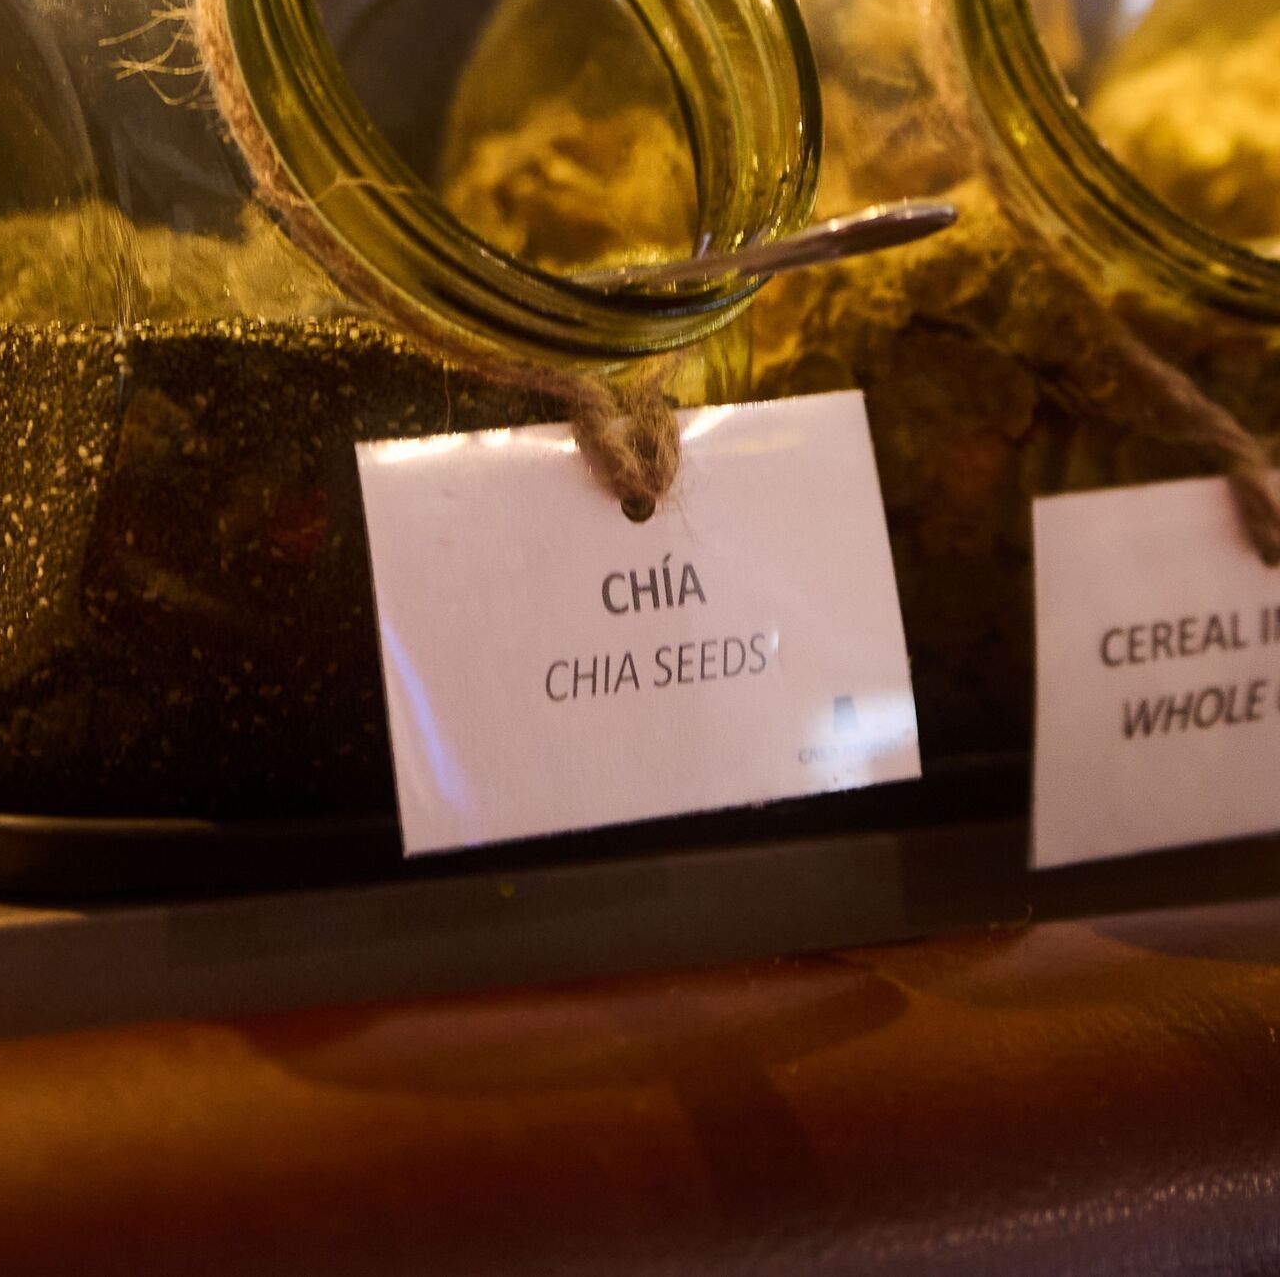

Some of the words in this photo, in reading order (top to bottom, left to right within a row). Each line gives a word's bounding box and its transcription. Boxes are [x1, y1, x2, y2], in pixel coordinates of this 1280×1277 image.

[601, 554, 706, 615] CHÍA
[545, 651, 640, 703] CHIA
[653, 633, 767, 689] SEEDS
[1100, 614, 1247, 667] CEREAL
[1123, 679, 1266, 740] WHOLE
